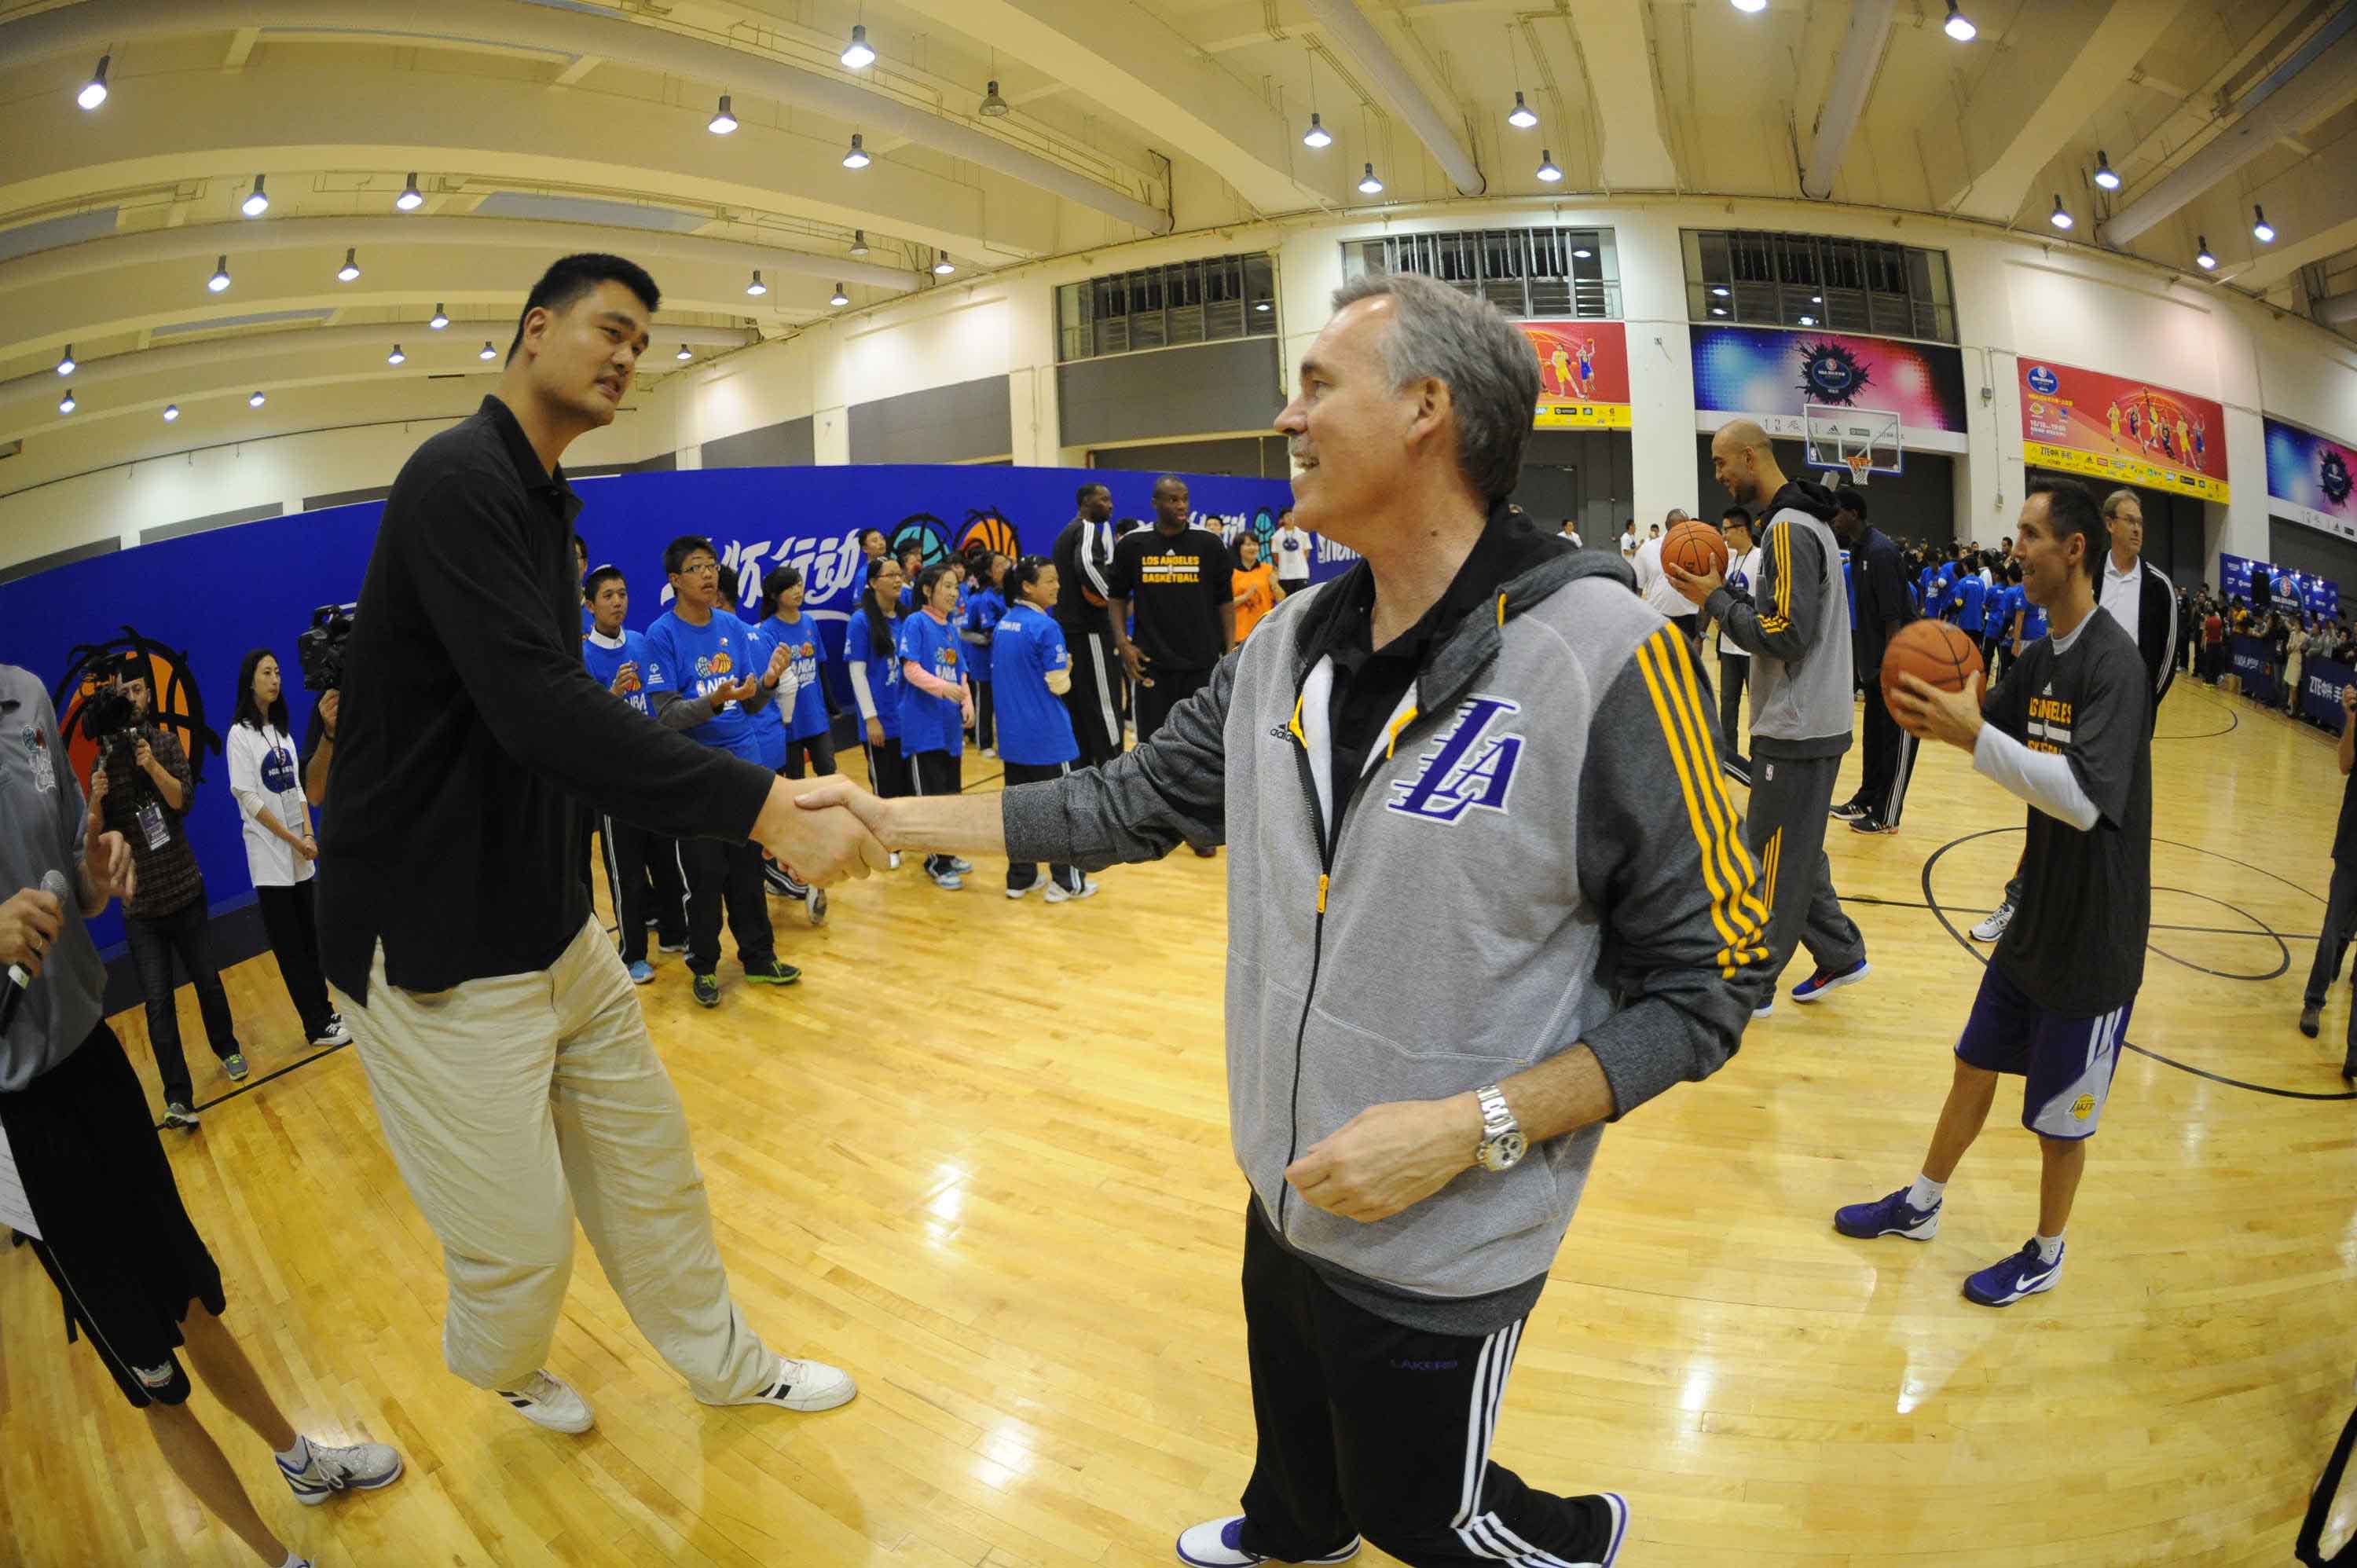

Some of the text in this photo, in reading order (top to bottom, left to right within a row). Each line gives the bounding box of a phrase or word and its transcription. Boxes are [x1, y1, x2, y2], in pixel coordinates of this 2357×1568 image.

[1142, 556, 1200, 566] LOS ANGELES
[1142, 573, 1200, 583] BASKETBALL
